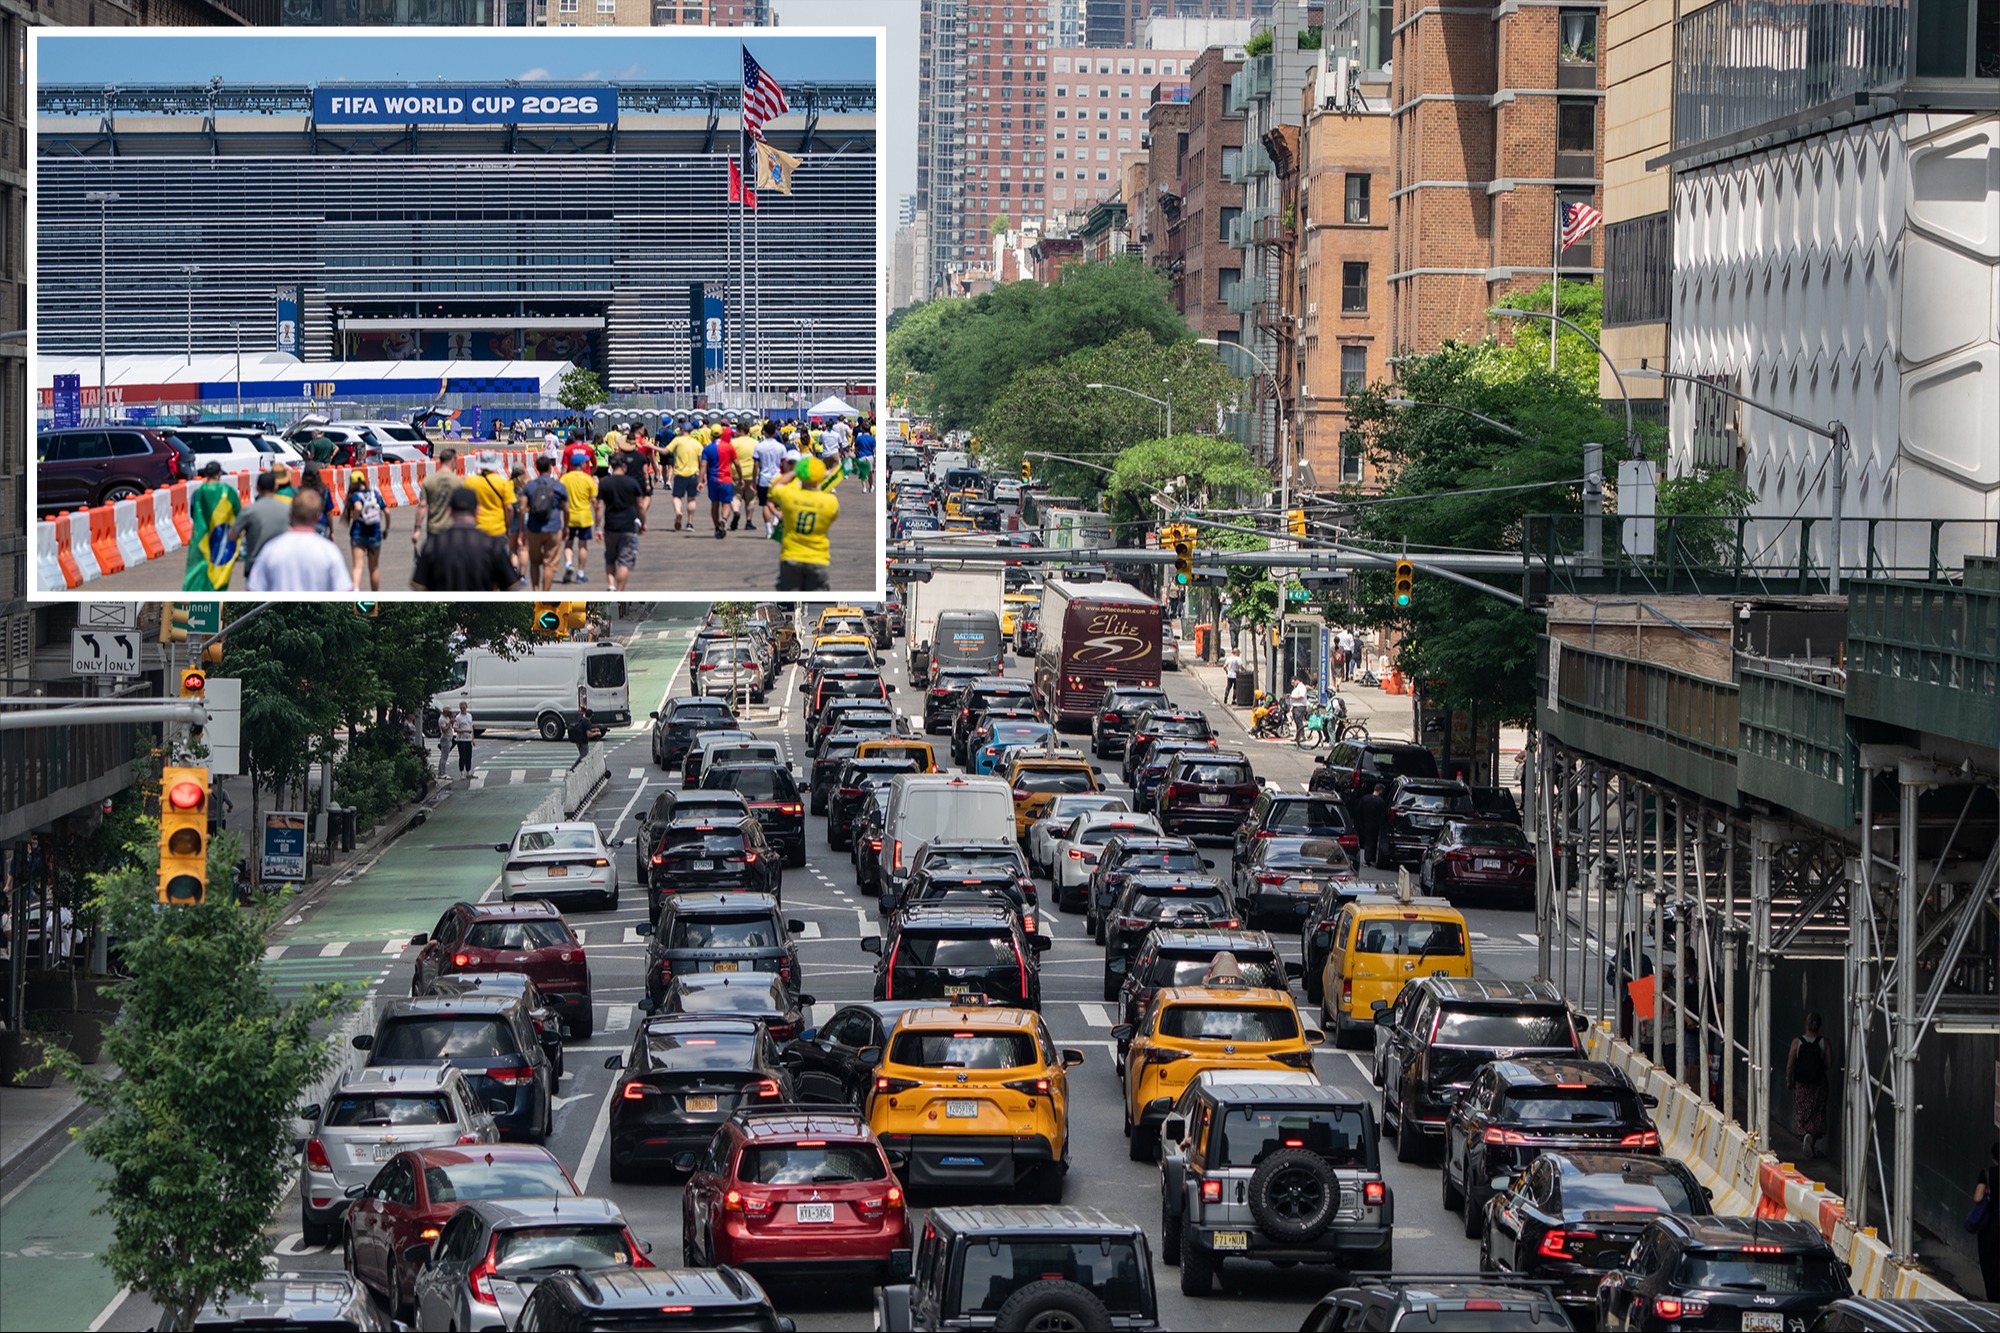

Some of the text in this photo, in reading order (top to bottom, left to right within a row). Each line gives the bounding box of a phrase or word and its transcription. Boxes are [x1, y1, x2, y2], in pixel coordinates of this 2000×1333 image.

[331, 96, 598, 114] FIFA WORLD CUP 2026
[313, 382, 336, 400] VIP
[796, 511, 816, 535] 10
[1085, 606, 1146, 615] www.elitecoach.com
[1087, 614, 1140, 636] Elite
[76, 661, 136, 671] ONLY ONLY
[1753, 1295, 1776, 1305] Jeep
